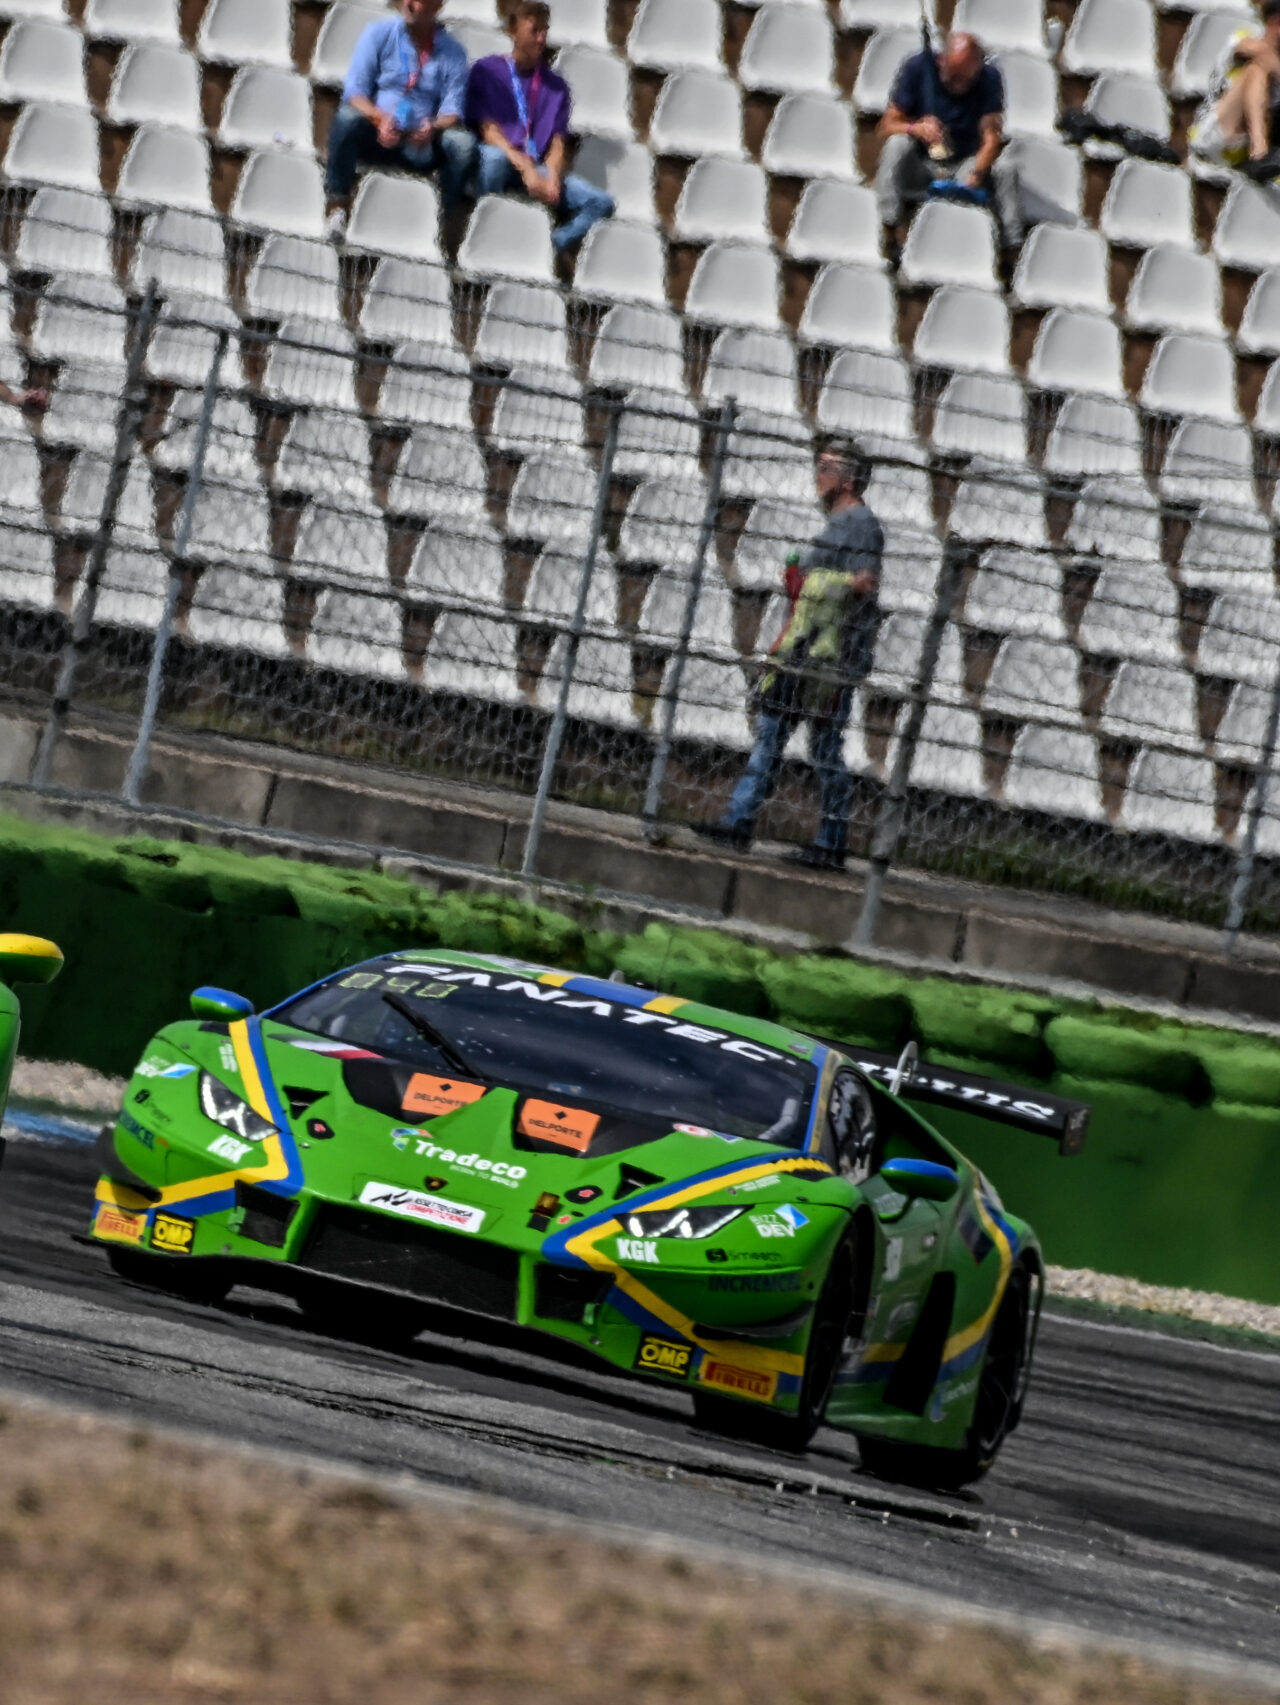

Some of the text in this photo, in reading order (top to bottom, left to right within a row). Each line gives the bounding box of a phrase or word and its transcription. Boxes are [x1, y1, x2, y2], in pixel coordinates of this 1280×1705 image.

[338, 972, 459, 998] 040
[384, 963, 785, 1062] FANATEC
[415, 1139, 527, 1179] Tradeco
[154, 1220, 193, 1246] OMP
[755, 1224, 795, 1238] DEV
[616, 1238, 660, 1264] KGK
[641, 1344, 689, 1368] OMP
[705, 1361, 771, 1397] PIRELLI
